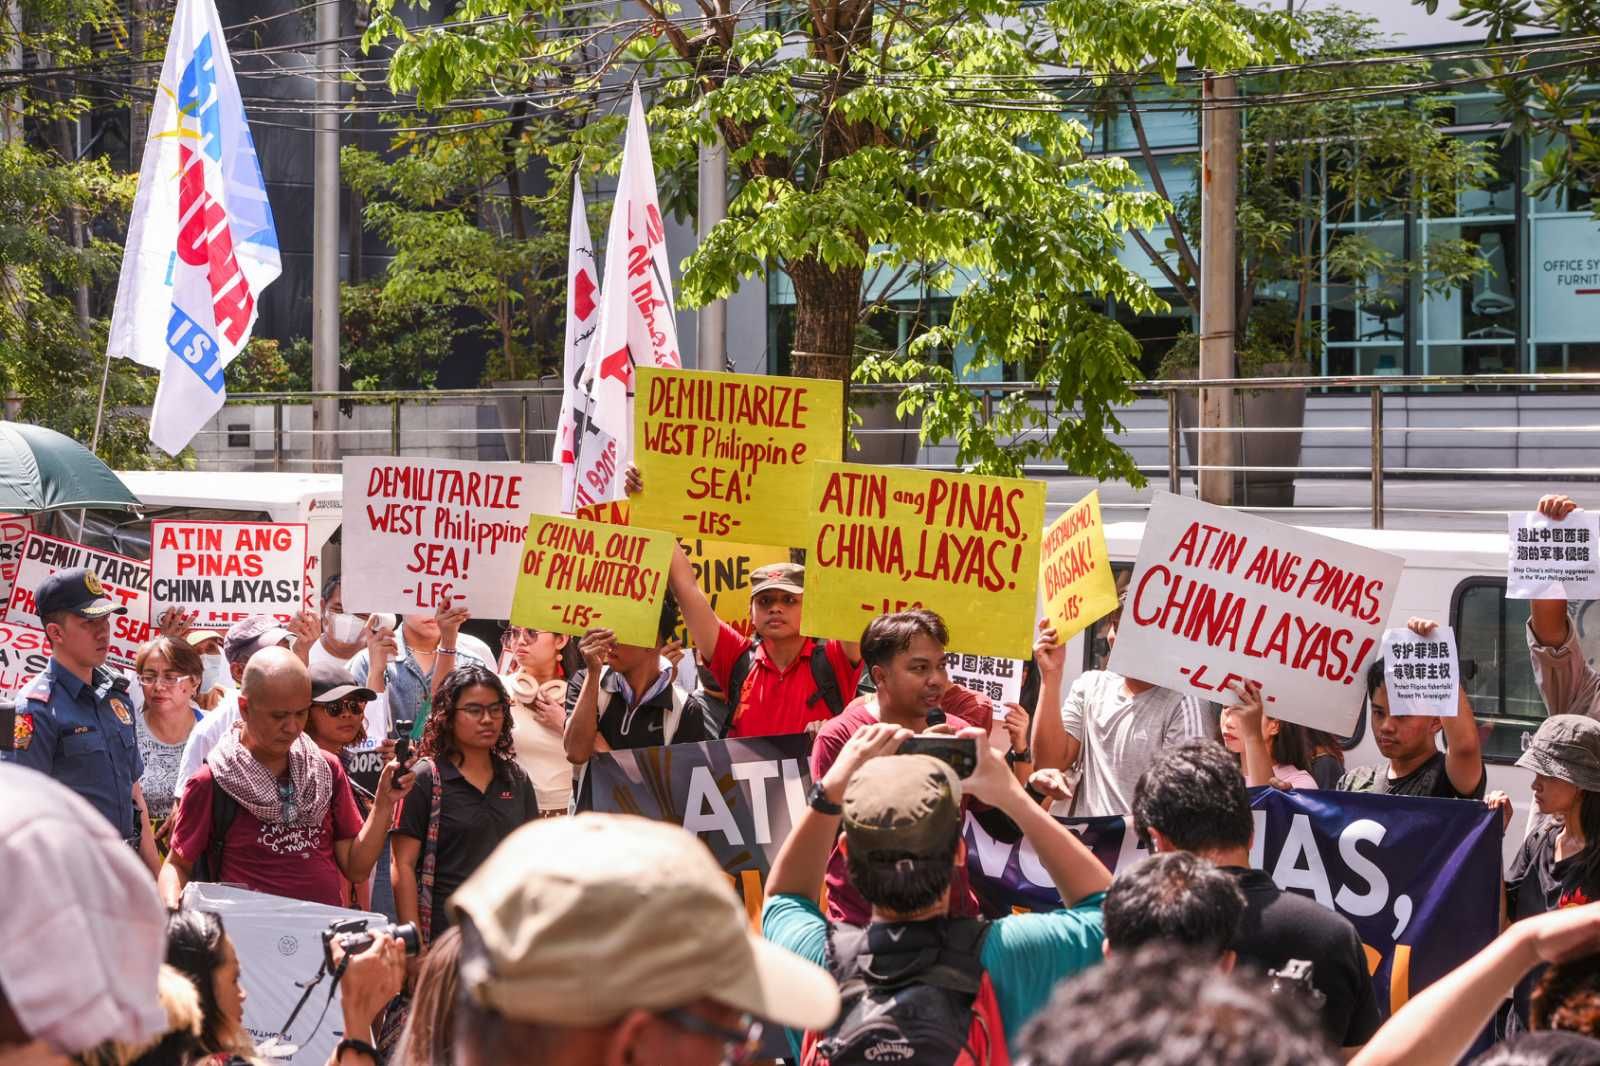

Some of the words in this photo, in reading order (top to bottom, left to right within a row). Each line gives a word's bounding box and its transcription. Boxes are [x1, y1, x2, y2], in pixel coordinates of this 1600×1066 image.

[1544, 260, 1584, 272] OFFICE
[1586, 259, 1600, 270] SY
[1558, 274, 1600, 285] FURNIT
[170, 319, 220, 381] IST
[648, 376, 808, 429] DEMILITARIZE
[644, 422, 698, 456] WEST
[703, 426, 807, 475] Philippine
[367, 466, 522, 509] DEMILITARIZE
[686, 466, 752, 505] SEA!
[818, 472, 888, 519] ATIN
[892, 490, 925, 515] ang
[925, 477, 1028, 541] PINAS,
[161, 527, 228, 551] ATIN
[236, 527, 292, 551] ANG
[366, 504, 426, 535] WEST
[683, 511, 742, 536] -LFS-
[26, 536, 150, 592] DEMILITARIZ
[406, 543, 470, 580] SEA!
[537, 522, 600, 558] CHINA,
[605, 532, 651, 564] OUT
[816, 523, 912, 582] CHINA,
[914, 529, 1023, 592] LAYAS!
[176, 553, 264, 577] PINAS
[523, 550, 545, 576] OF
[545, 552, 577, 590] PH
[575, 557, 661, 605] WATERS!
[1169, 521, 1248, 574] ATIN
[1244, 545, 1302, 593] ANG
[1297, 558, 1384, 625] PINAS,
[152, 579, 216, 603] CHINA
[221, 580, 301, 604] LAYAS!
[209, 611, 292, 623] HED
[551, 604, 602, 628] -LFS-
[1132, 564, 1247, 652] CHINA
[1242, 604, 1375, 685] LAYAS!
[682, 758, 803, 846] ATI
